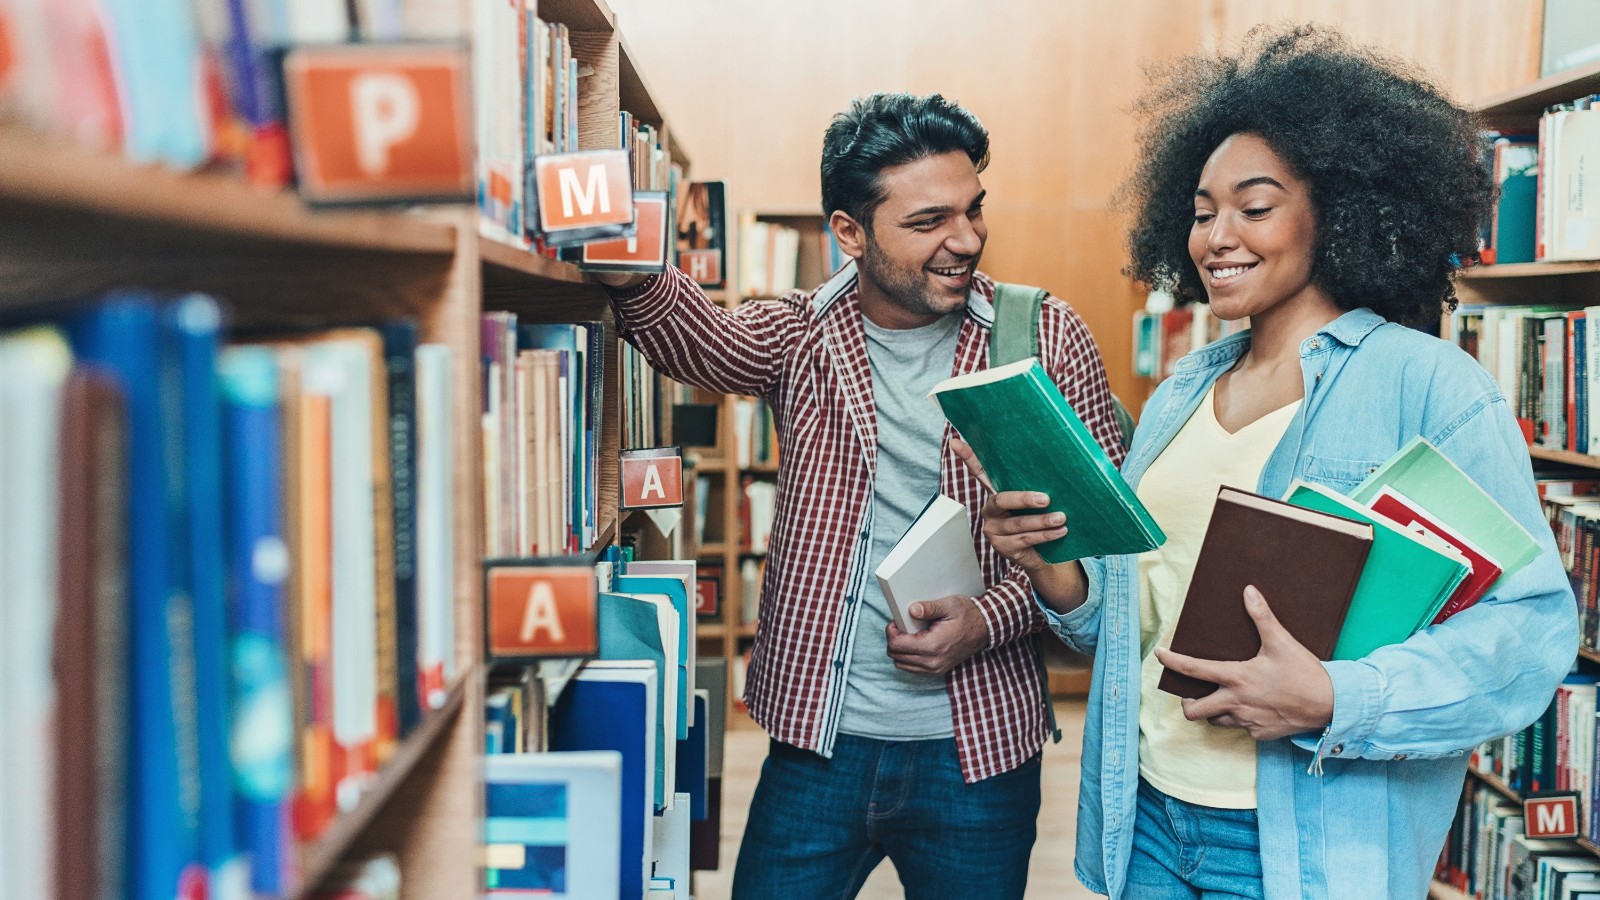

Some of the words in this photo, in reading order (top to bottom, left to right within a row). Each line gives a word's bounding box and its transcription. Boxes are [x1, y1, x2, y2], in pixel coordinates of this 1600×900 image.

[349, 74, 420, 174] P
[558, 163, 611, 218] M
[690, 256, 708, 280] H
[640, 464, 666, 500] A
[520, 581, 564, 642] A
[1537, 804, 1565, 833] M
